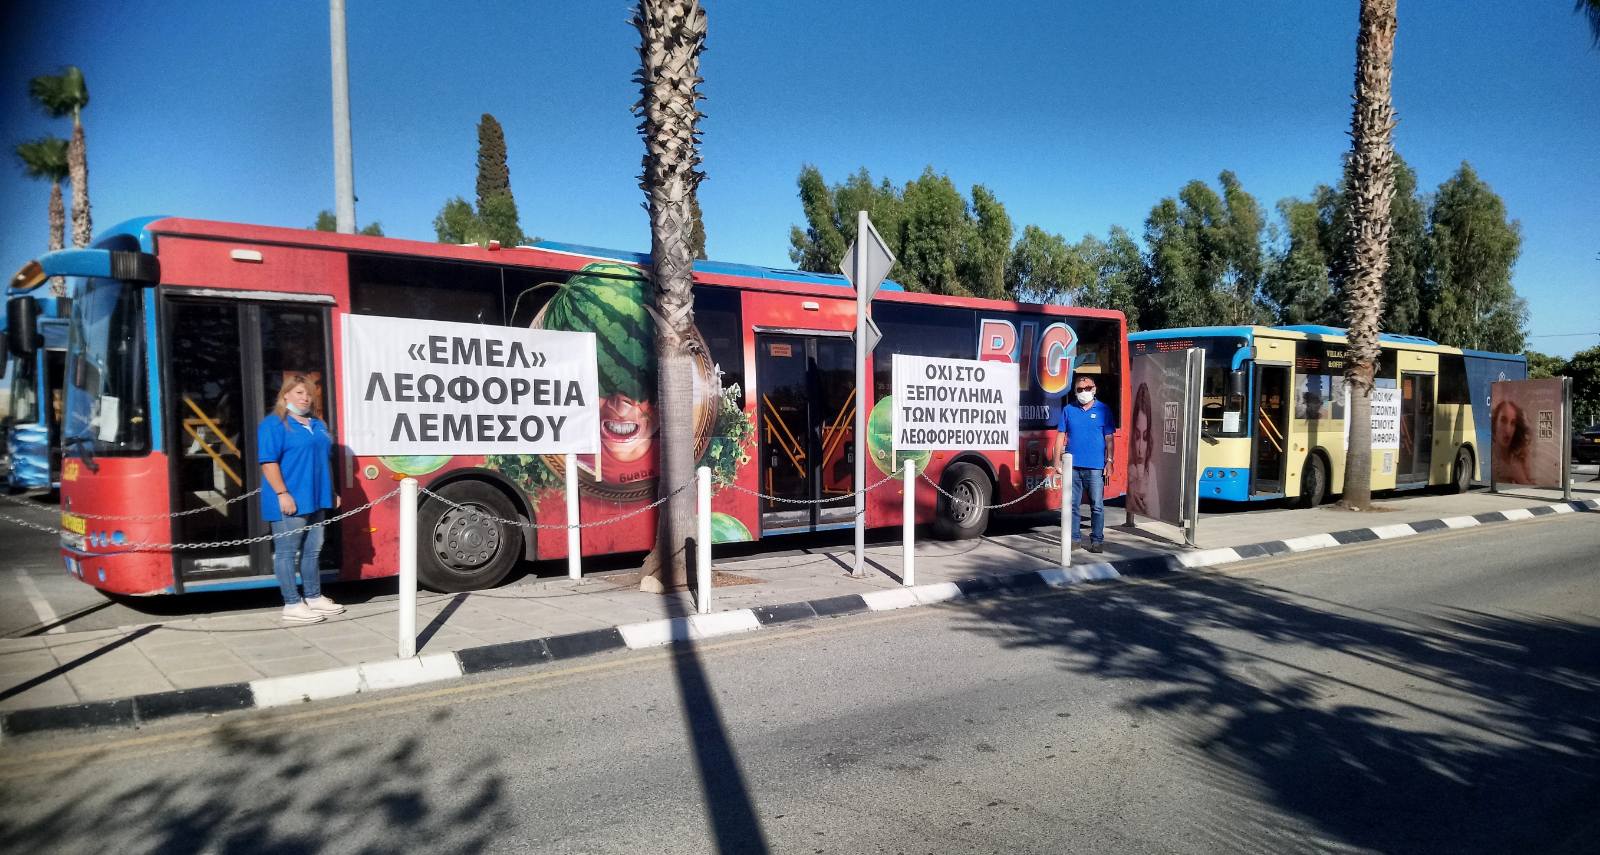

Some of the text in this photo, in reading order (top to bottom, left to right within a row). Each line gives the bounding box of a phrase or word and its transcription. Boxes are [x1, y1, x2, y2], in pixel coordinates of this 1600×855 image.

[407, 335, 547, 369] «ΕΜΕΛ»
[977, 318, 1079, 395] BIG
[925, 364, 986, 383] ΟΧΙ ΣΤΟ
[364, 372, 585, 407] ΛΕΩΦΟΡΕΙΑ
[906, 384, 1004, 404] ΞΕΠΟΥΛΗΜΑ
[902, 406, 1007, 425] ΤΩΝ ΚΥΠΡΙΩΝ
[1019, 405, 1050, 420] URDAYS
[389, 412, 568, 443] ΛΕΜΕΣΟΥ
[1371, 419, 1395, 430] ΕΣΜΟΥΣ
[900, 428, 1009, 445] ΛΕΩΦΟΡΕΙΟΥΧΩΝ
